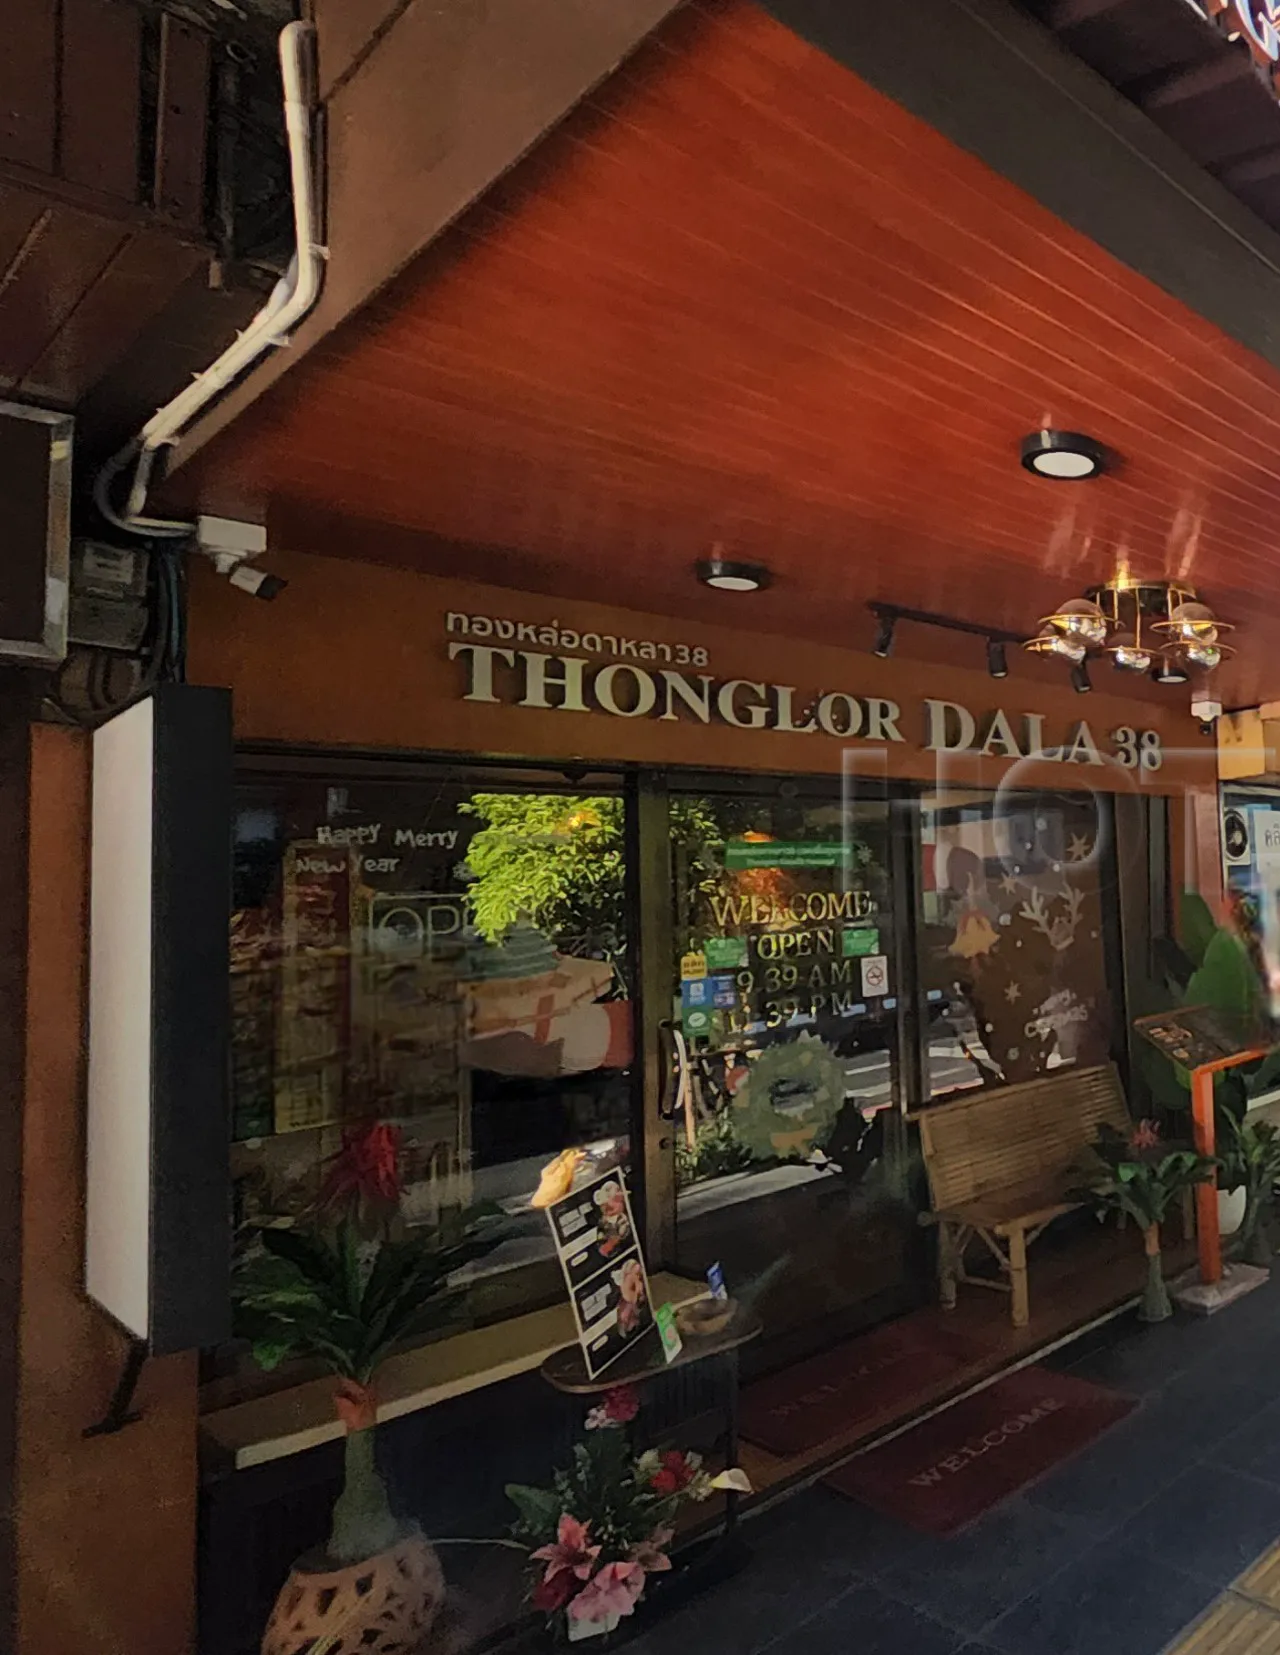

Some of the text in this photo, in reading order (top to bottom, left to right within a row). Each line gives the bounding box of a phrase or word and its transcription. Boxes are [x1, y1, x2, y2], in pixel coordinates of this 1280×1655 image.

[446, 610, 709, 668] ทองหล่อดาหลา38
[447, 641, 1163, 771] THONGLOR DALA 38
[316, 823, 459, 849] Happy Merry
[296, 855, 401, 874] New Year
[709, 890, 873, 927] WELCOME
[758, 929, 835, 960] OPEN
[907, 1397, 1067, 1488] WELCOME
